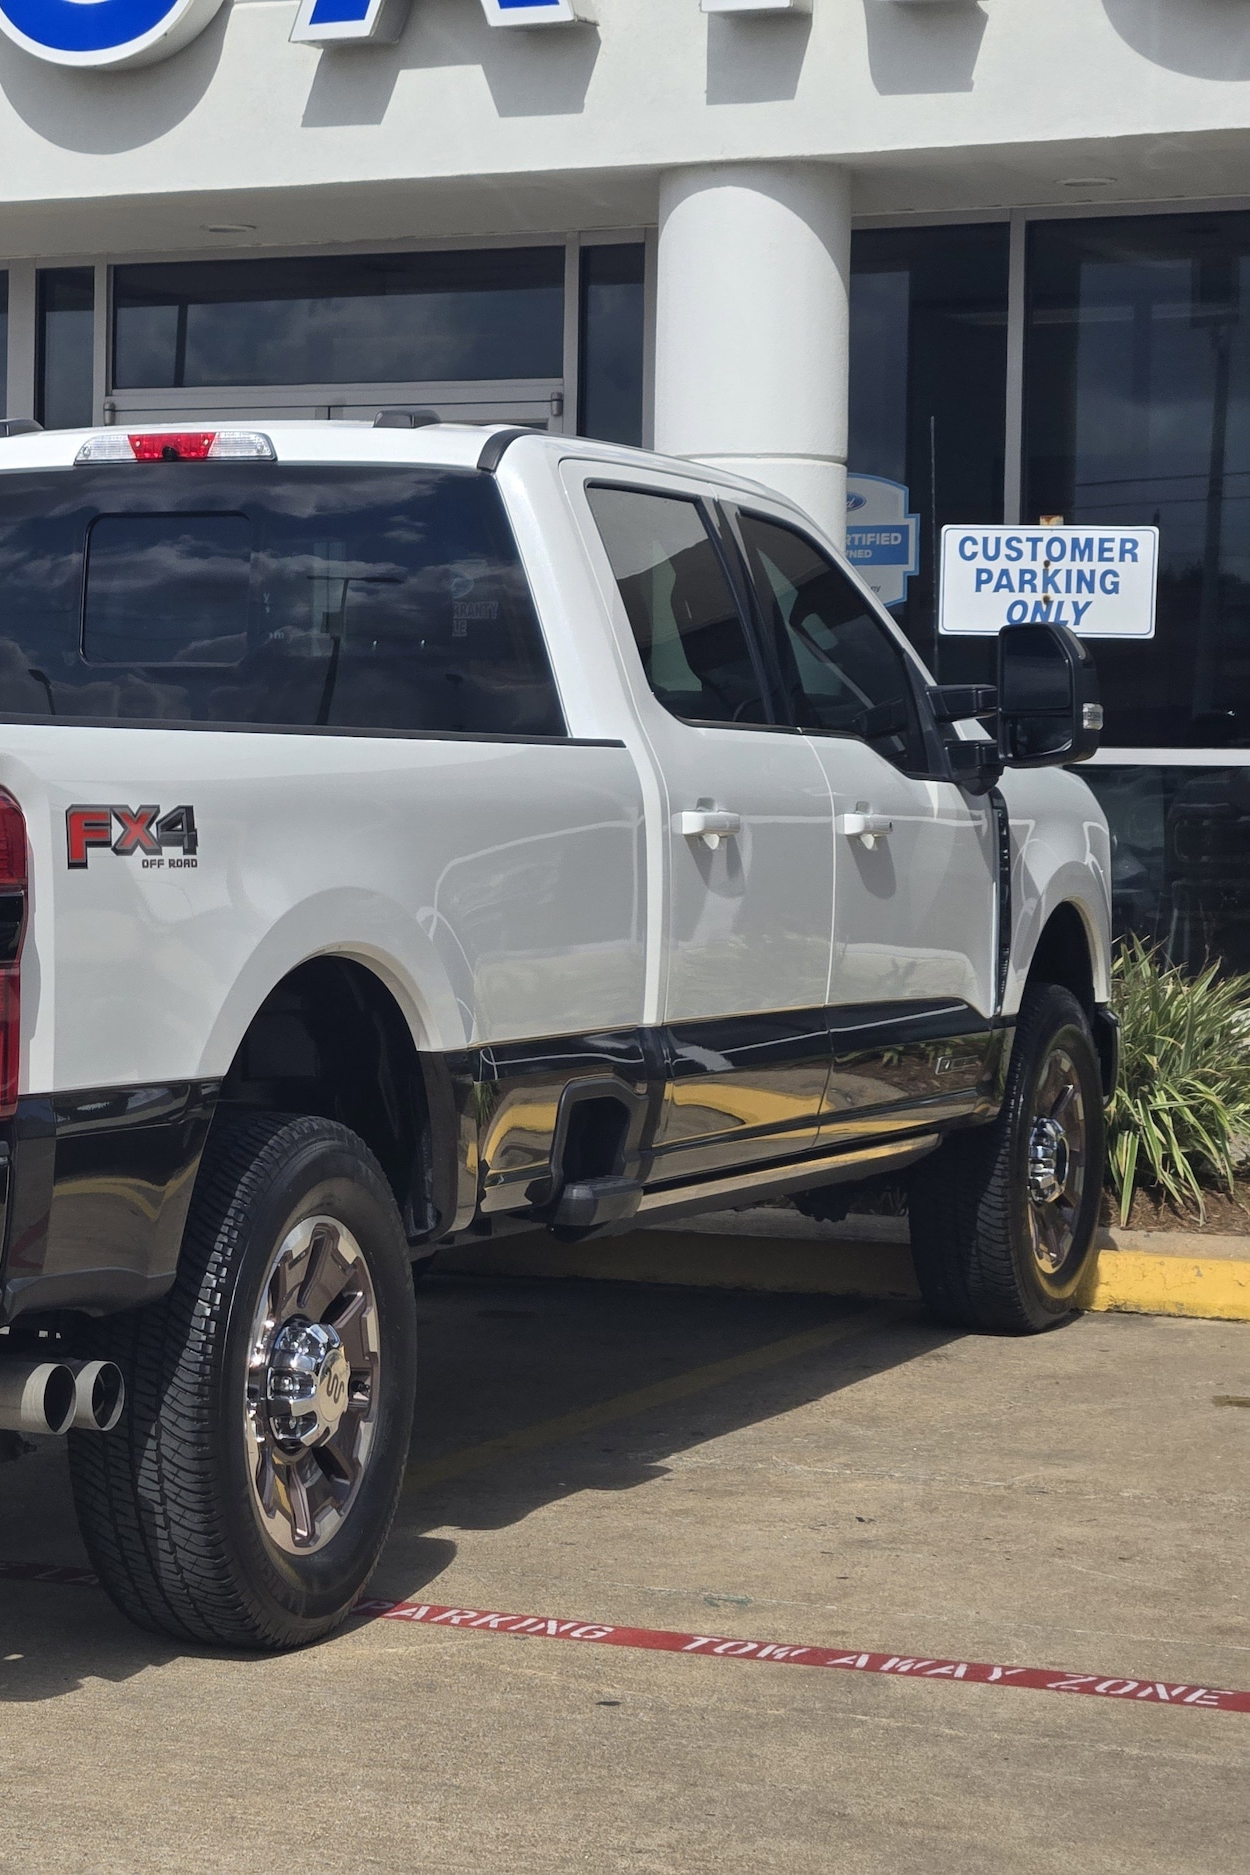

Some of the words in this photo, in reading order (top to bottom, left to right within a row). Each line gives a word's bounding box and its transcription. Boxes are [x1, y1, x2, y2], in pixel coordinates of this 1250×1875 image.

[958, 536, 1140, 564] CUSTOMER
[975, 569, 1120, 595] PARKING
[1006, 600, 1092, 626] ONLY
[65, 803, 198, 870] FX4
[141, 858, 165, 869] OFF
[168, 858, 198, 869] ROAD
[350, 1600, 616, 1640] PARKING
[682, 1635, 808, 1661] TOW
[827, 1652, 1027, 1682] AWAY
[1046, 1674, 1235, 1706] ZONE
